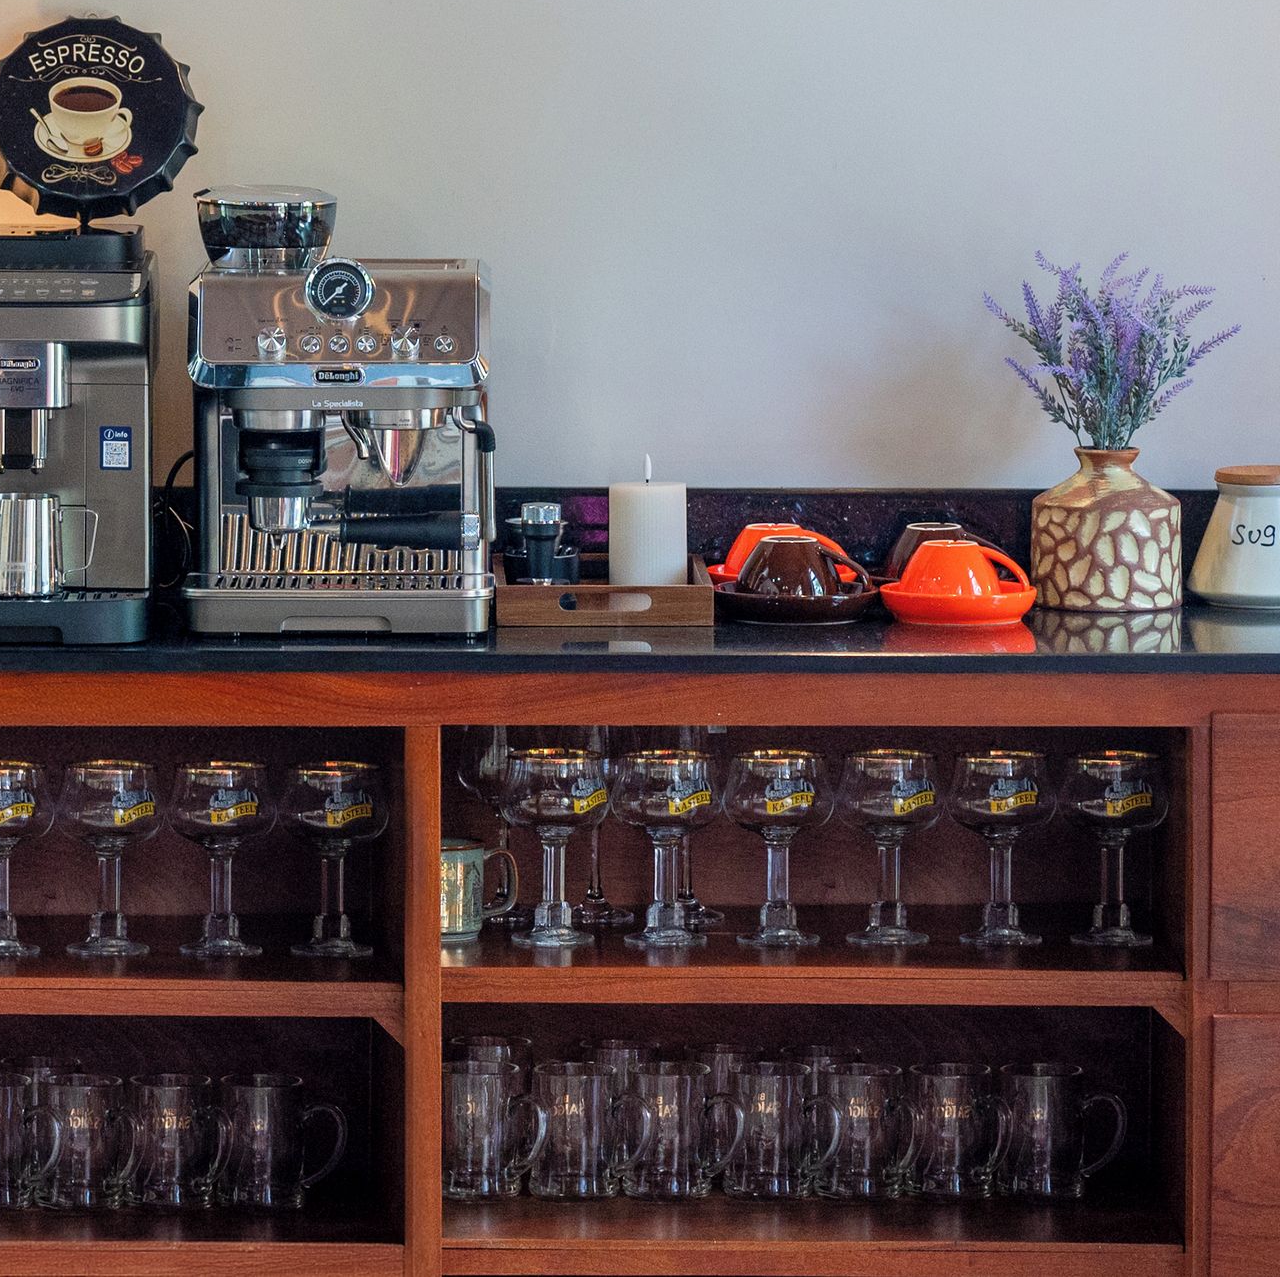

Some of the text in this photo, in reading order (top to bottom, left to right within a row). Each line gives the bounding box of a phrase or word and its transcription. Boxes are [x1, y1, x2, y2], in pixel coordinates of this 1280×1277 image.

[28, 43, 146, 74] ESPRESSO
[324, 399, 364, 409] Specialista
[114, 430, 129, 439] info
